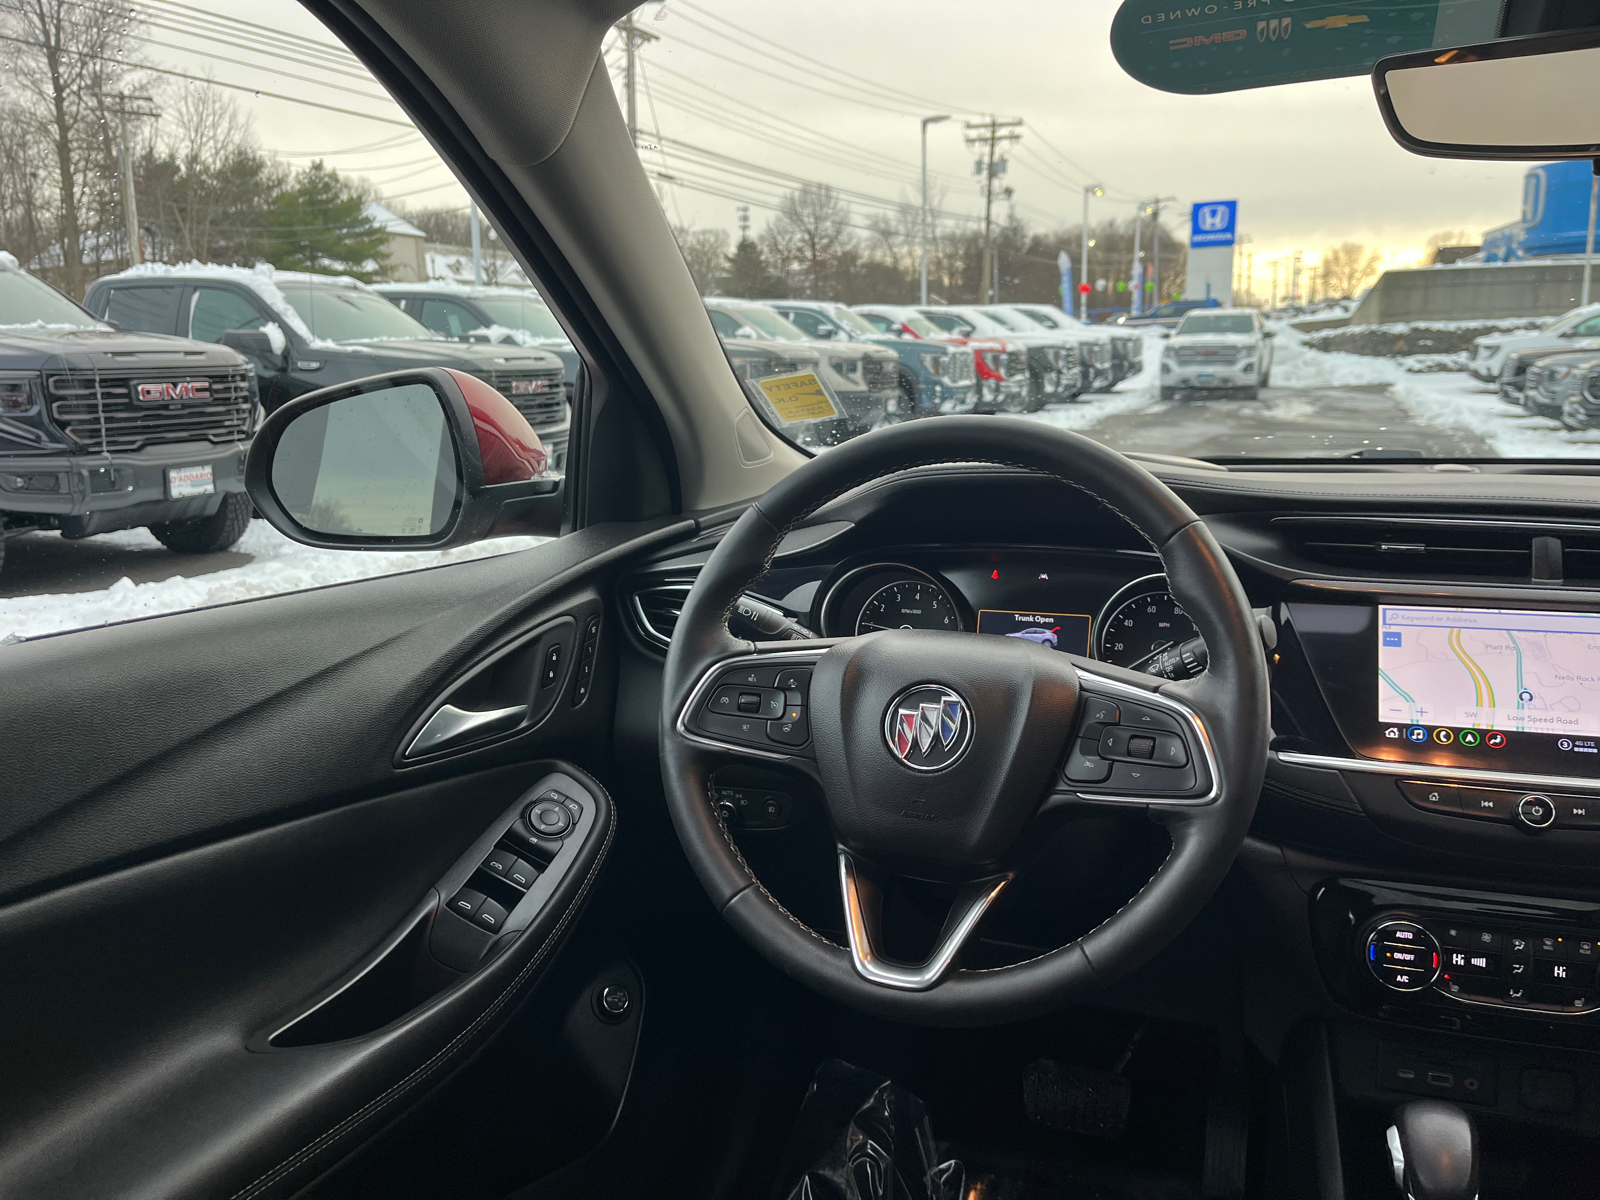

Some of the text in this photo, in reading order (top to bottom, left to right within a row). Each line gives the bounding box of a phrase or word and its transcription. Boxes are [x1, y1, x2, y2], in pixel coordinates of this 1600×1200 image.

[138, 381, 211, 401] GMC
[511, 380, 550, 395] GMC
[896, 594, 901, 602] 3
[915, 592, 920, 600] 4
[880, 604, 885, 612] 2
[932, 600, 937, 609] 5
[1147, 605, 1157, 613] 60
[943, 616, 949, 624] 6
[1014, 614, 1054, 624] Trunk Open
[1123, 619, 1134, 627] 40
[1401, 614, 1434, 624] Keyword
[1445, 616, 1477, 624] Address
[1114, 643, 1124, 651] 20
[1486, 643, 1503, 651] Platt
[1164, 658, 1176, 666] AUTO
[1507, 714, 1579, 725] Low Speed Road
[1395, 931, 1413, 940] AUTO
[1393, 952, 1415, 961] ON/OFF
[1453, 953, 1465, 966] Hi
[1554, 965, 1567, 978] Hi
[1396, 974, 1409, 983] A/C
